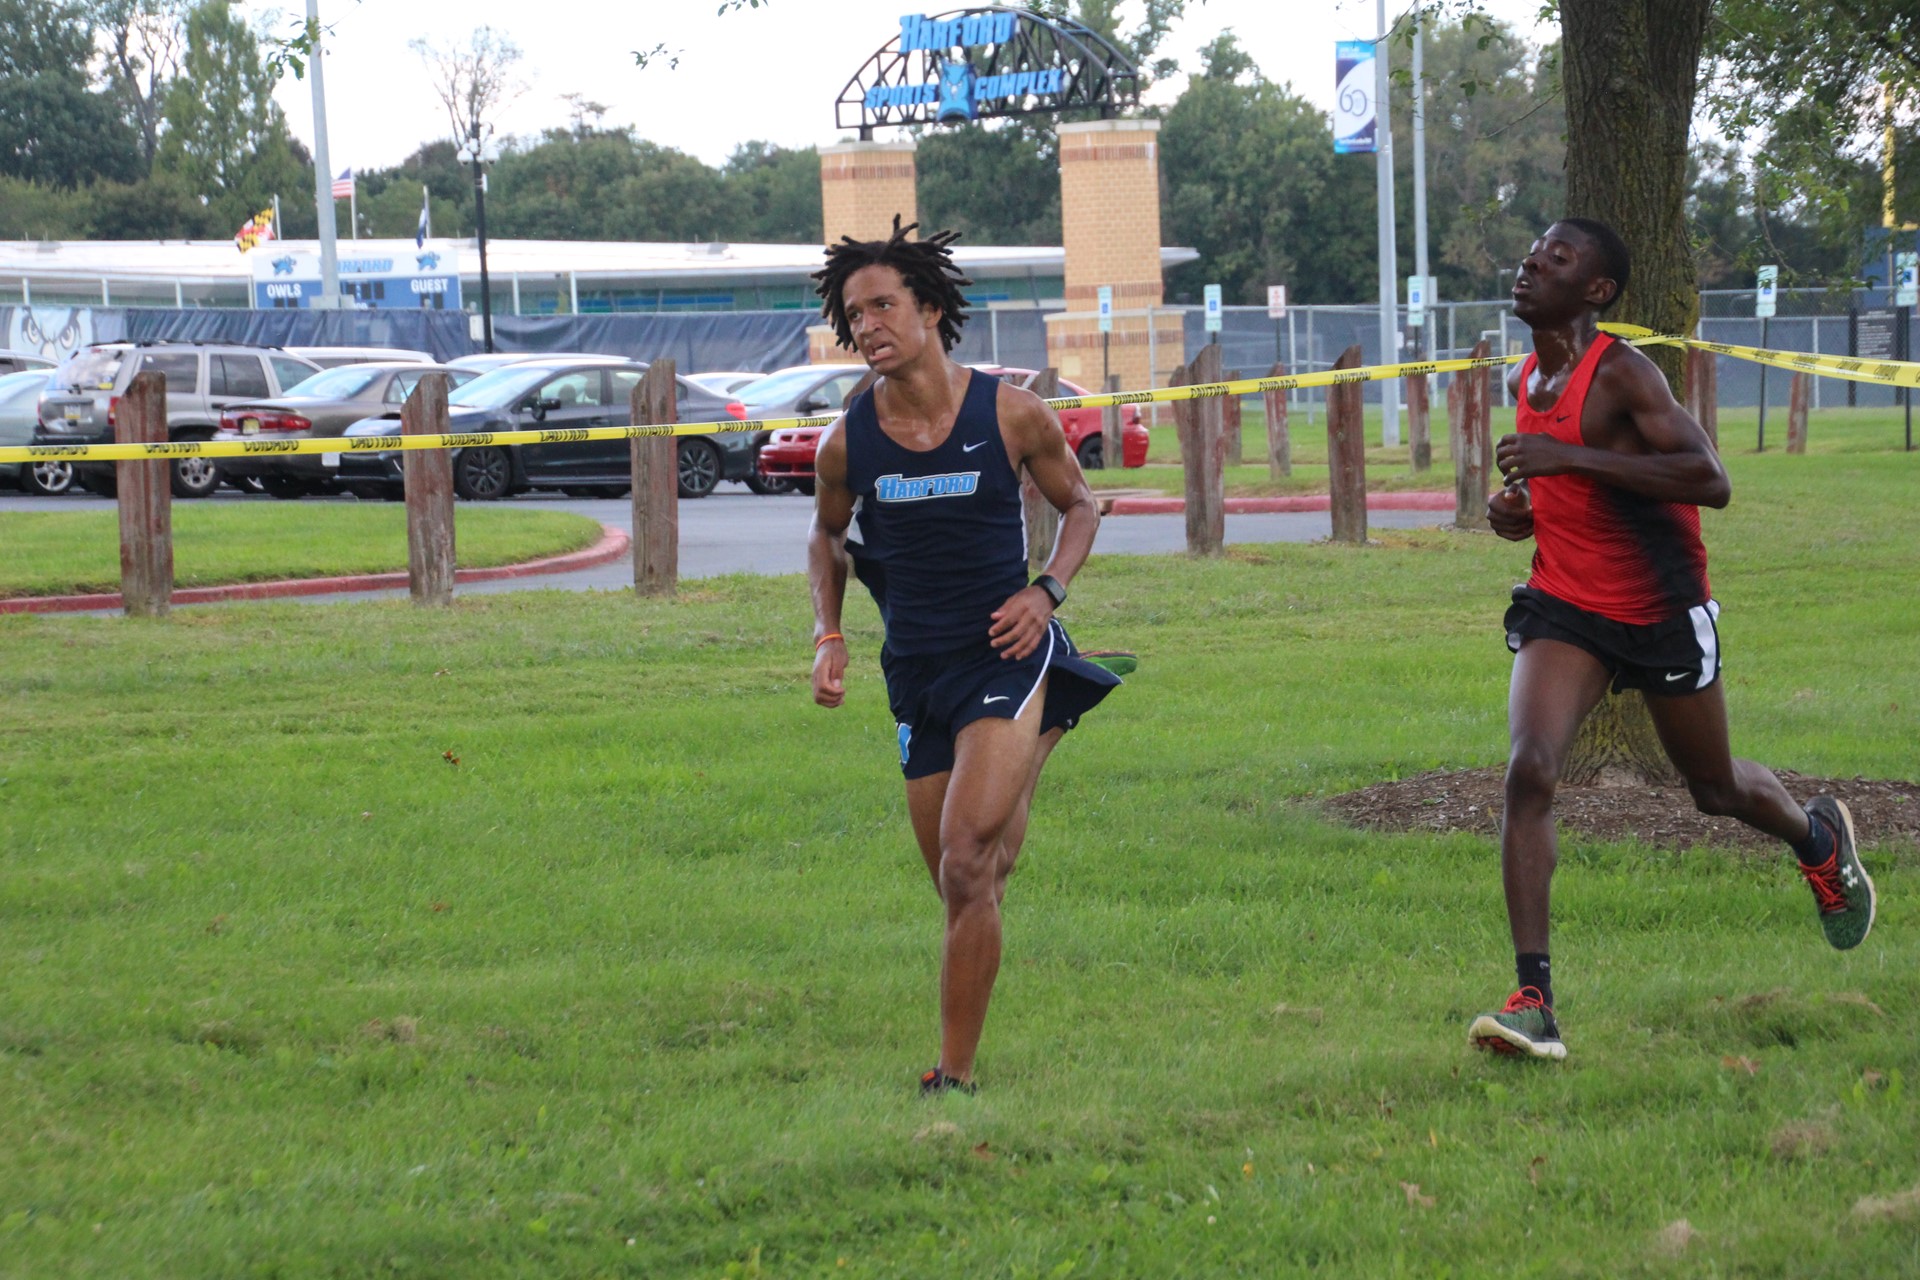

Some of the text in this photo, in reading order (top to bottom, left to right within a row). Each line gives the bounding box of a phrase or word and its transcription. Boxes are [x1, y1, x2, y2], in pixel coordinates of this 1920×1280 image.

[900, 12, 1016, 54] HARFORD
[864, 69, 1063, 109] SPORTS COMPLEX
[267, 283, 302, 298] OWLS
[410, 278, 449, 293] GUEST
[876, 474, 979, 501] HARFORD
